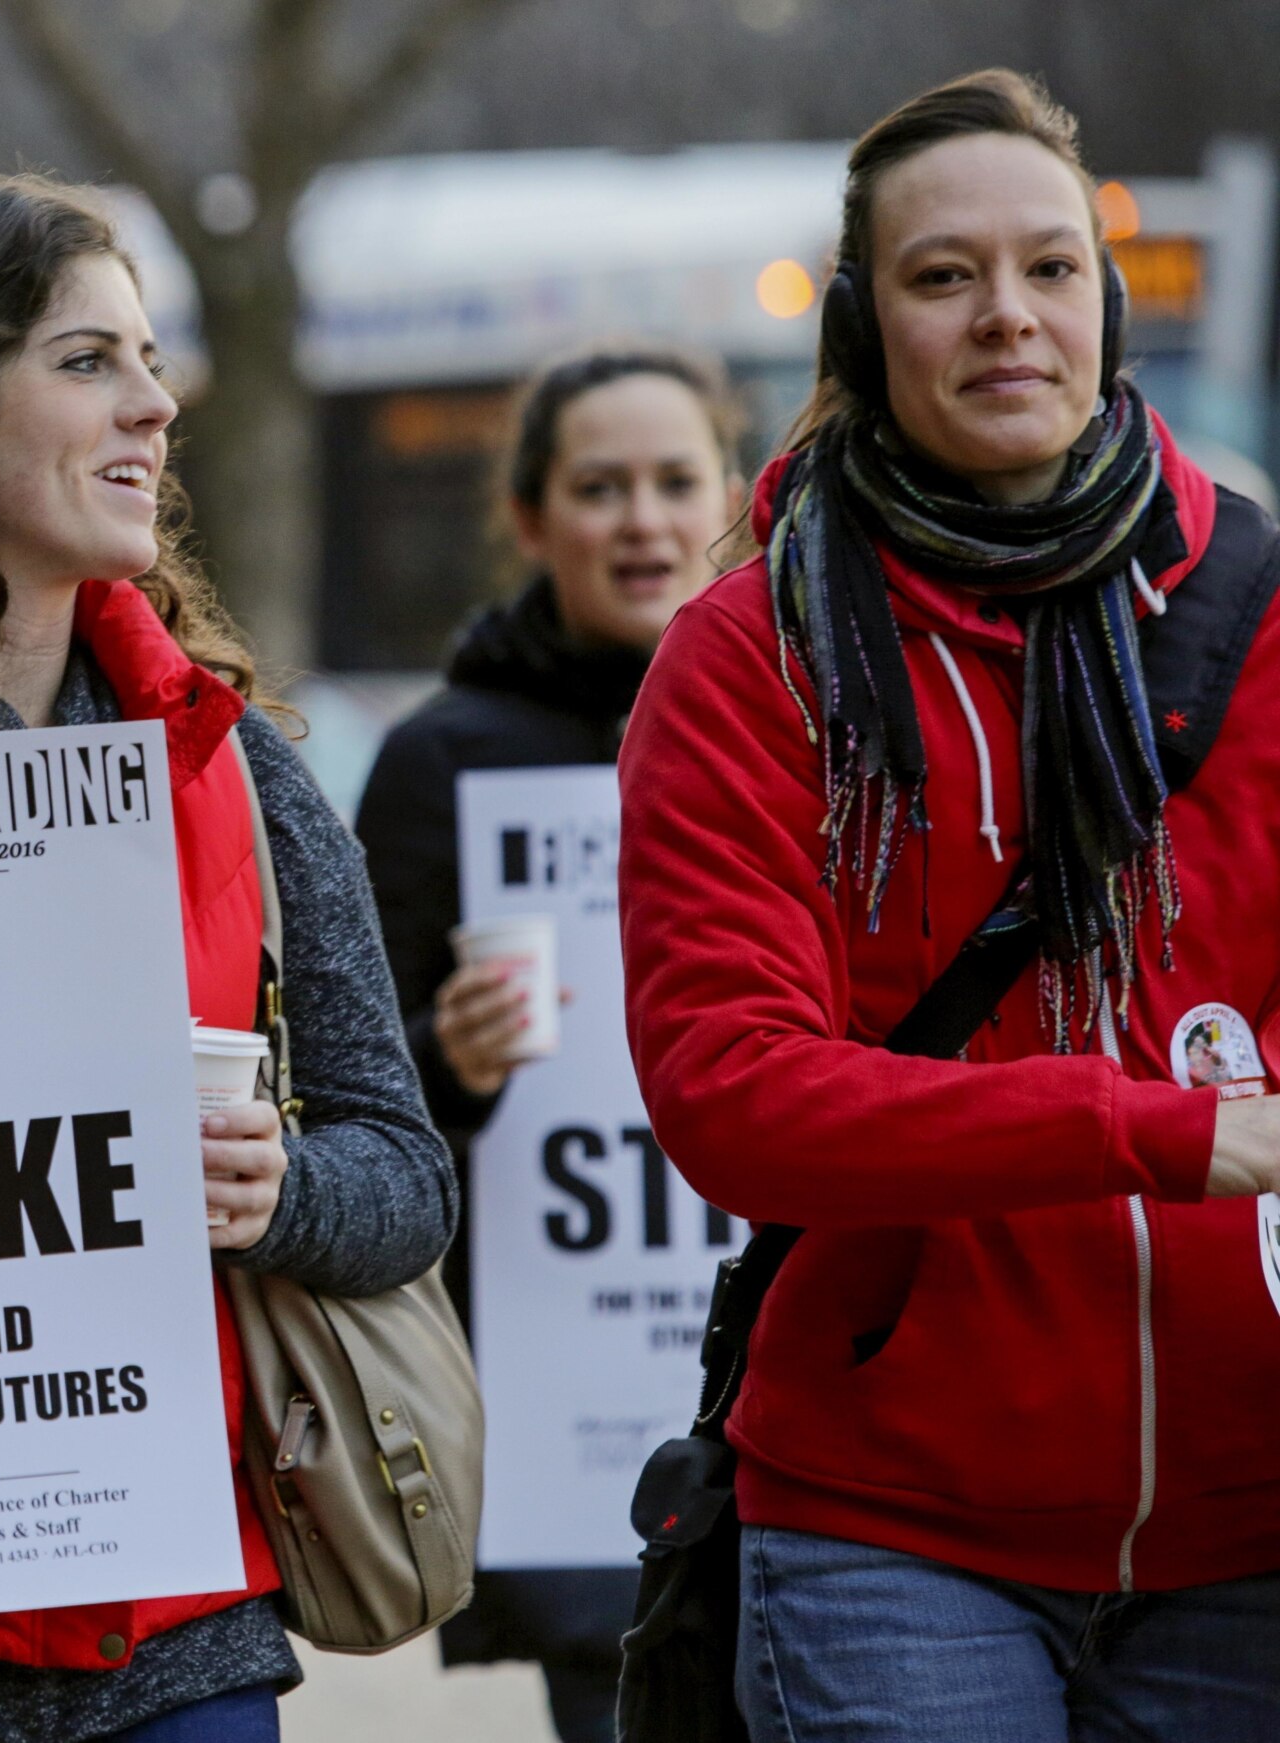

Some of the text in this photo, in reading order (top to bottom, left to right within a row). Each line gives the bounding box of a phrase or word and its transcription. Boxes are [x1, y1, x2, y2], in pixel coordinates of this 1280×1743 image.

[30, 1492, 49, 1508] of
[54, 1487, 130, 1507] Charter
[12, 1522, 29, 1539] &
[35, 1517, 82, 1537] Staff
[7, 1548, 40, 1563] 4343
[52, 1540, 119, 1560] AFL-CIO
